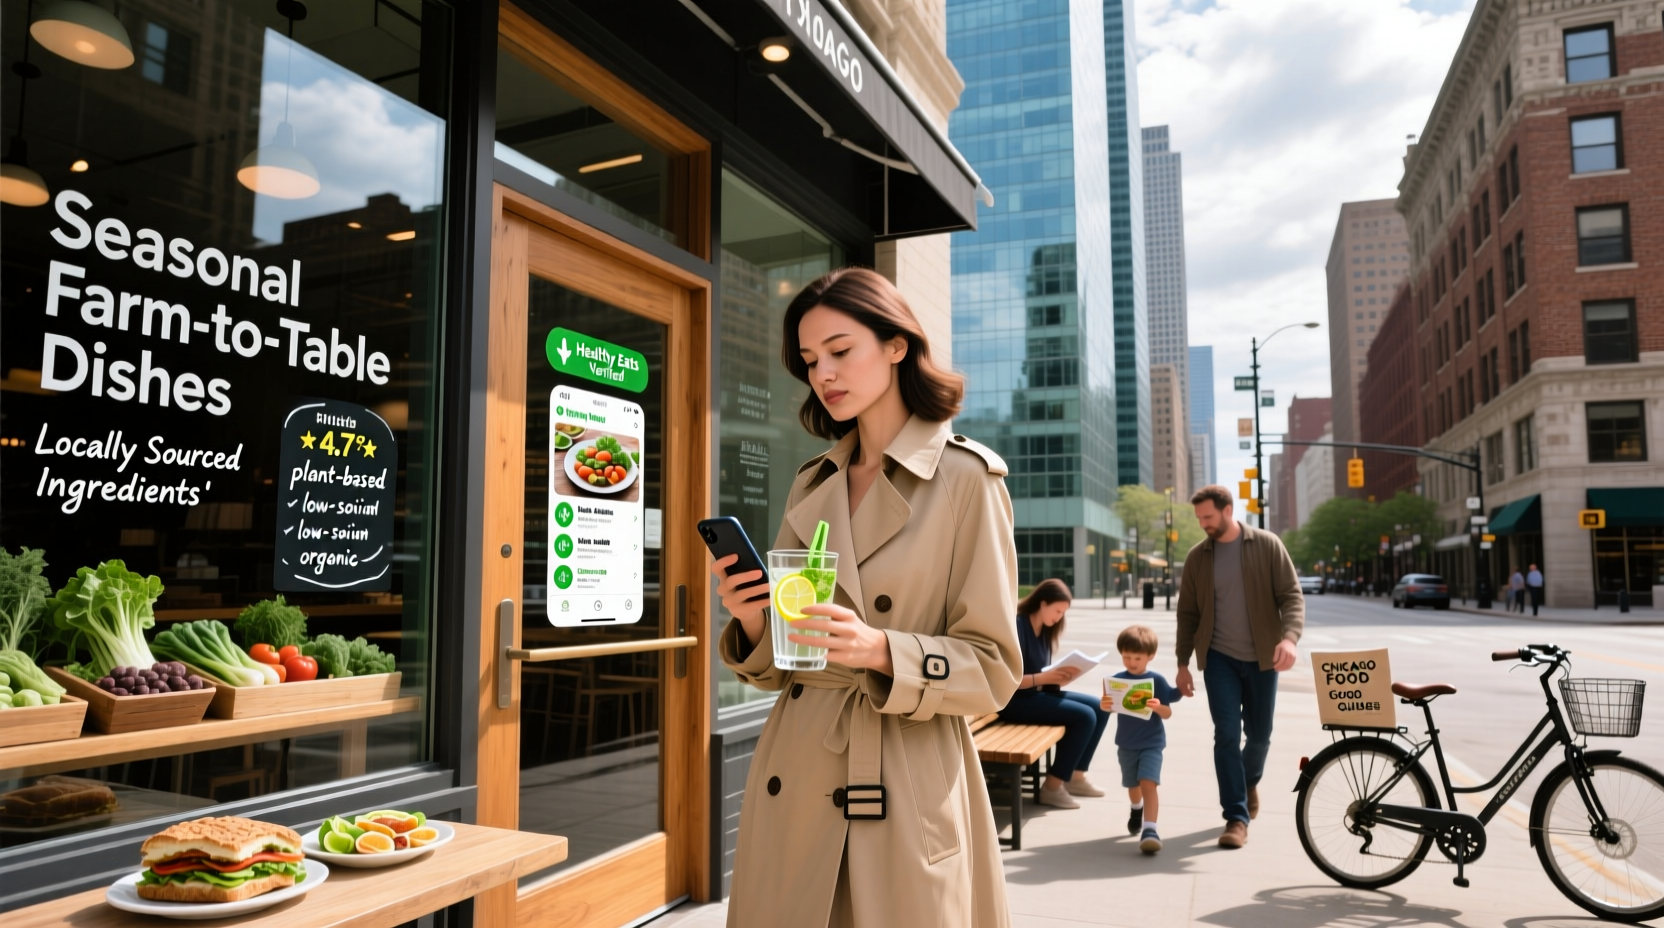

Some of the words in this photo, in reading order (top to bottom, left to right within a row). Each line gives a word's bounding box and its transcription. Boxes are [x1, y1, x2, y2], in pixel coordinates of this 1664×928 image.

[50, 190, 301, 307] Seasonal
[45, 260, 391, 385] Farm-to-Table
[40, 332, 232, 416] Dishes
[34, 422, 138, 473] Locally
[144, 435, 244, 471] Sourced
[289, 459, 388, 491] plant-based
[299, 548, 359, 575] organic
[1326, 672, 1370, 685] FOOD
